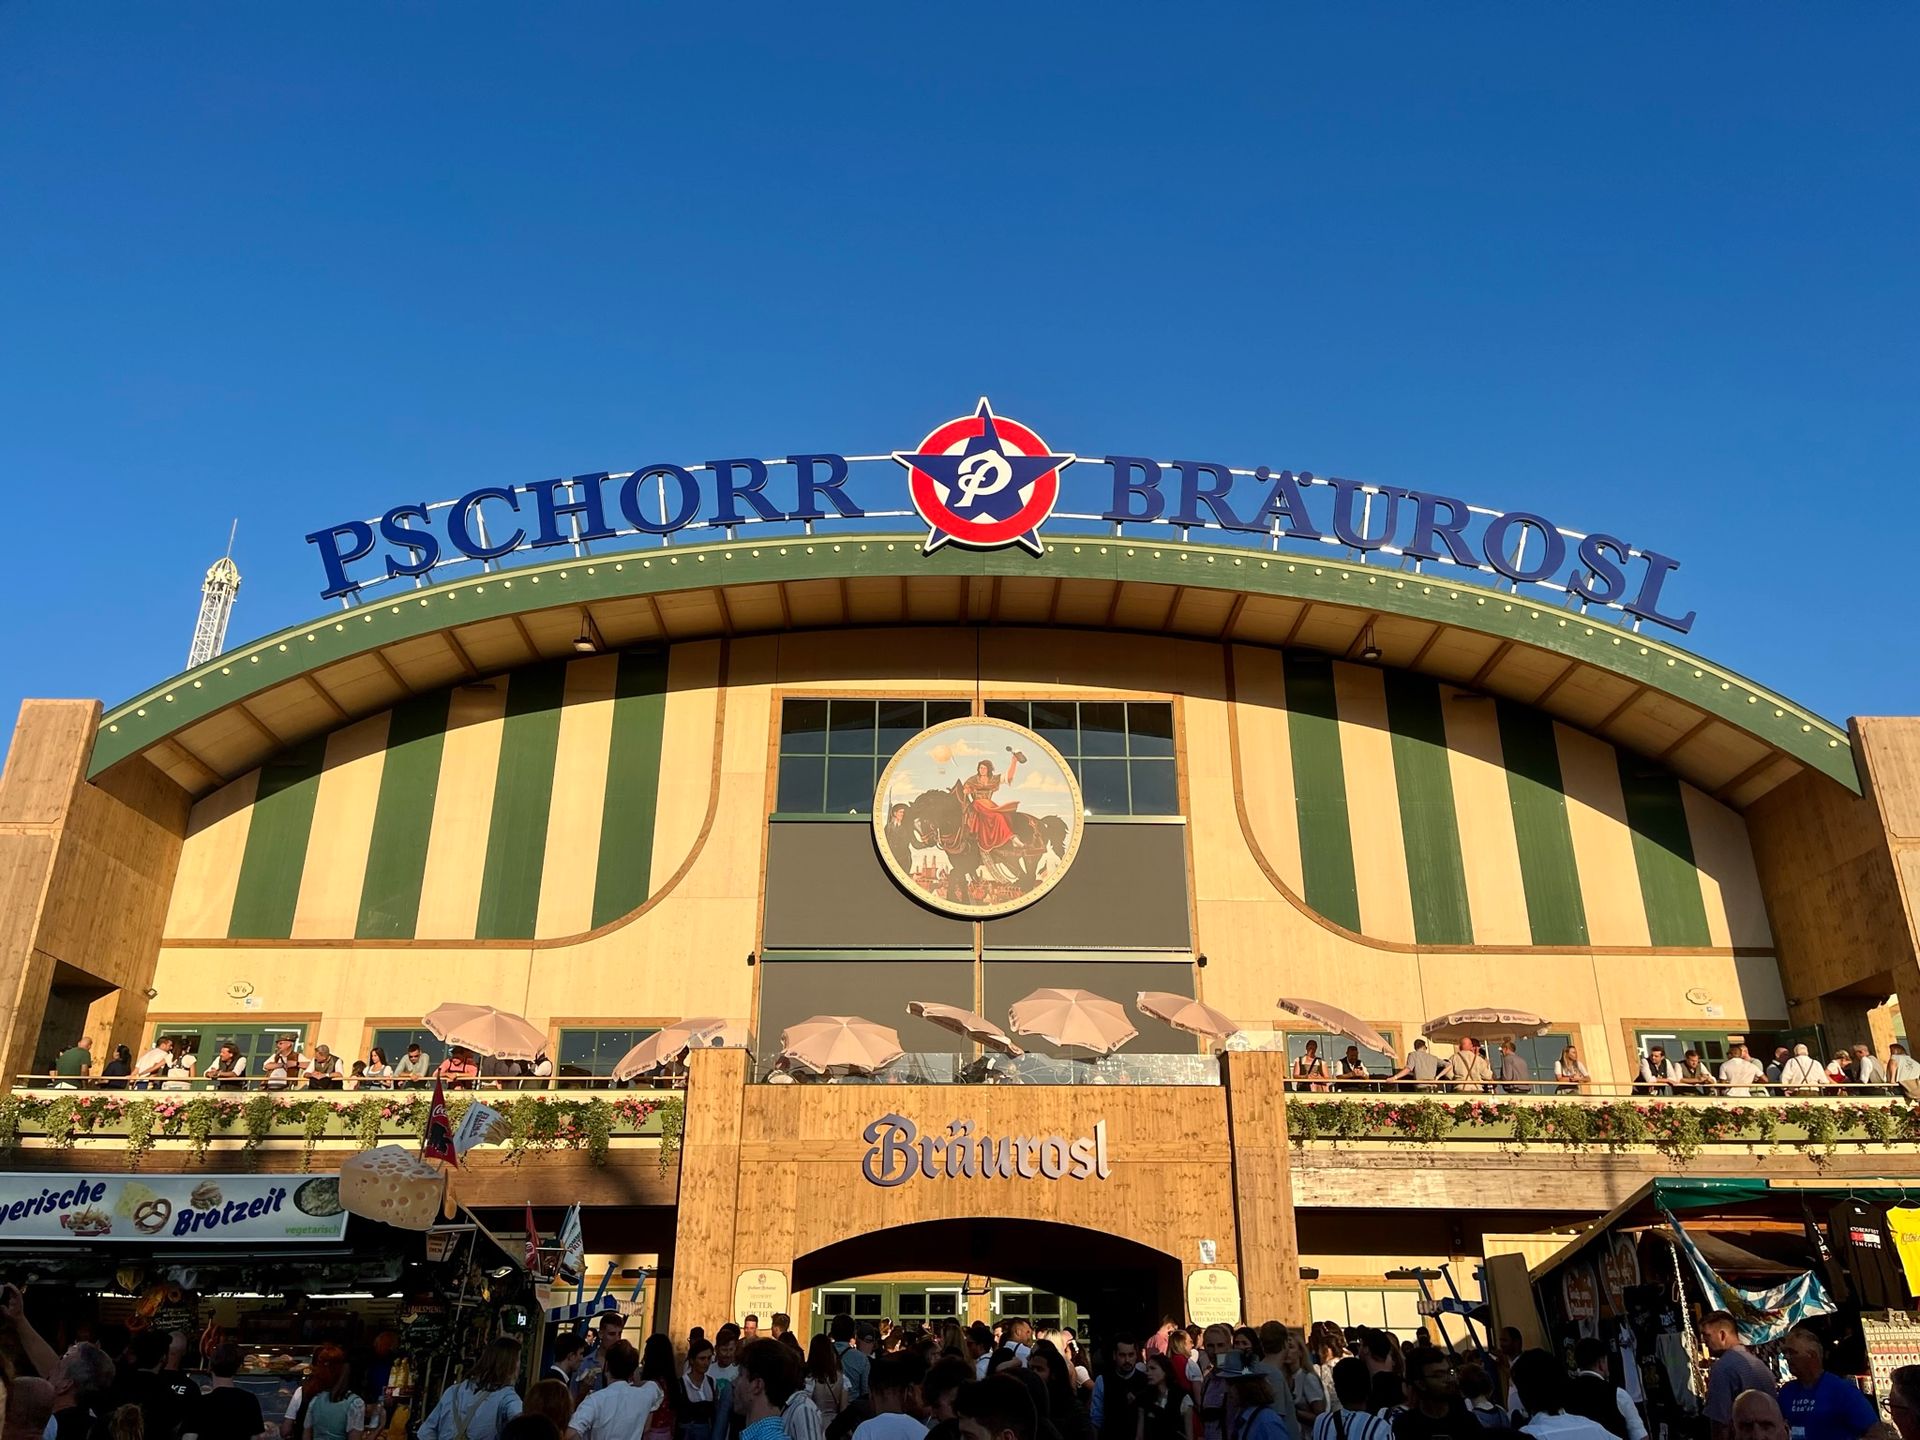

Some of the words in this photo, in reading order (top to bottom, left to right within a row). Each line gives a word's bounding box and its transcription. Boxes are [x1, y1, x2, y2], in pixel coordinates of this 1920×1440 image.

[953, 449, 1013, 508] P
[305, 453, 866, 600] PSCHORR
[1102, 455, 1696, 634] BRÄUROSL
[862, 1112, 1112, 1187] Bräurosl
[173, 1187, 286, 1237] Brotzeit
[285, 1223, 340, 1236] vegetarisch
